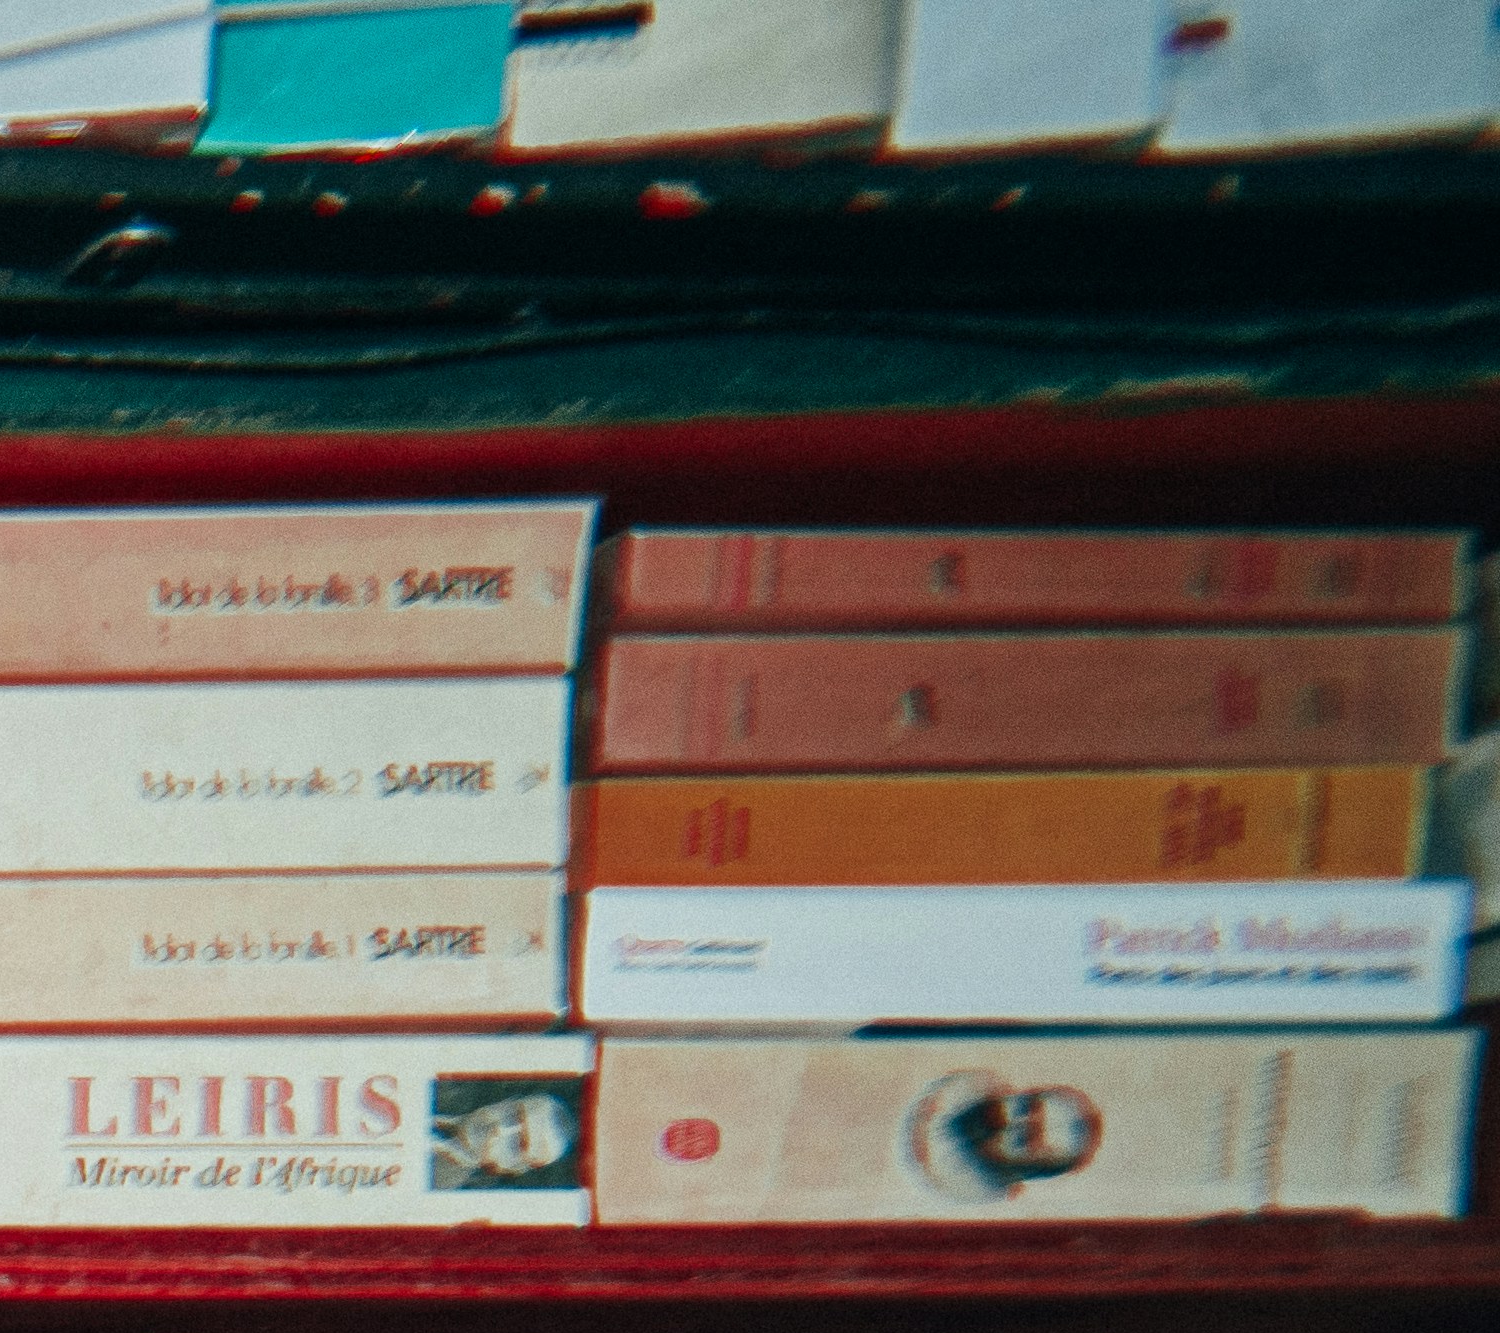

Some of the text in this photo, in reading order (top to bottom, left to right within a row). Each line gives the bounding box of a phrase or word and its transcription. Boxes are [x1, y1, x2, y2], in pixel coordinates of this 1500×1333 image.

[64, 1074, 405, 1138] LEIRIS
[68, 1154, 405, 1193] Miroir de l'Afrique
